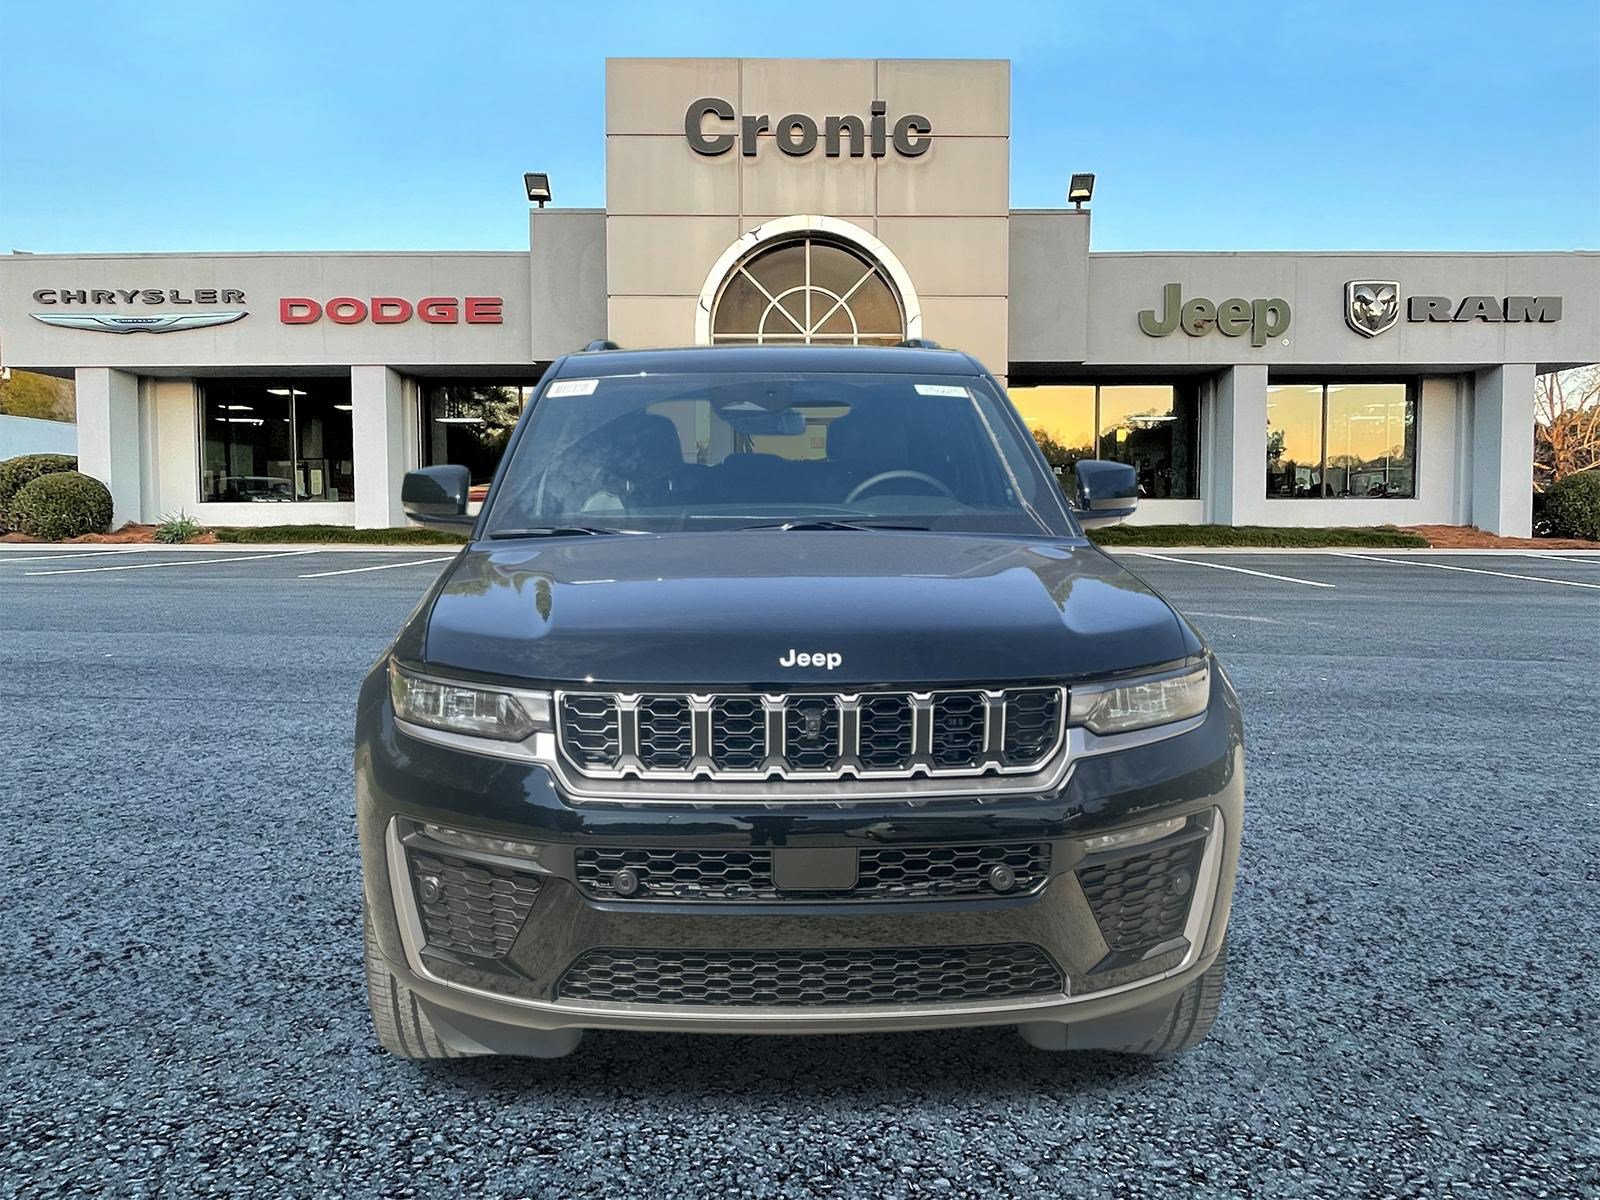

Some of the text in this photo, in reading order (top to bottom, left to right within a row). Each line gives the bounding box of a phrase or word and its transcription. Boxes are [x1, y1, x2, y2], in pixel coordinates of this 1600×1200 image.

[684, 97, 932, 157] Cronic
[32, 288, 247, 305] CHRYSLER
[1407, 296, 1563, 323] RAM
[279, 297, 504, 325] DODGE
[1137, 283, 1292, 348] Jeep
[779, 649, 842, 670] Jeep
